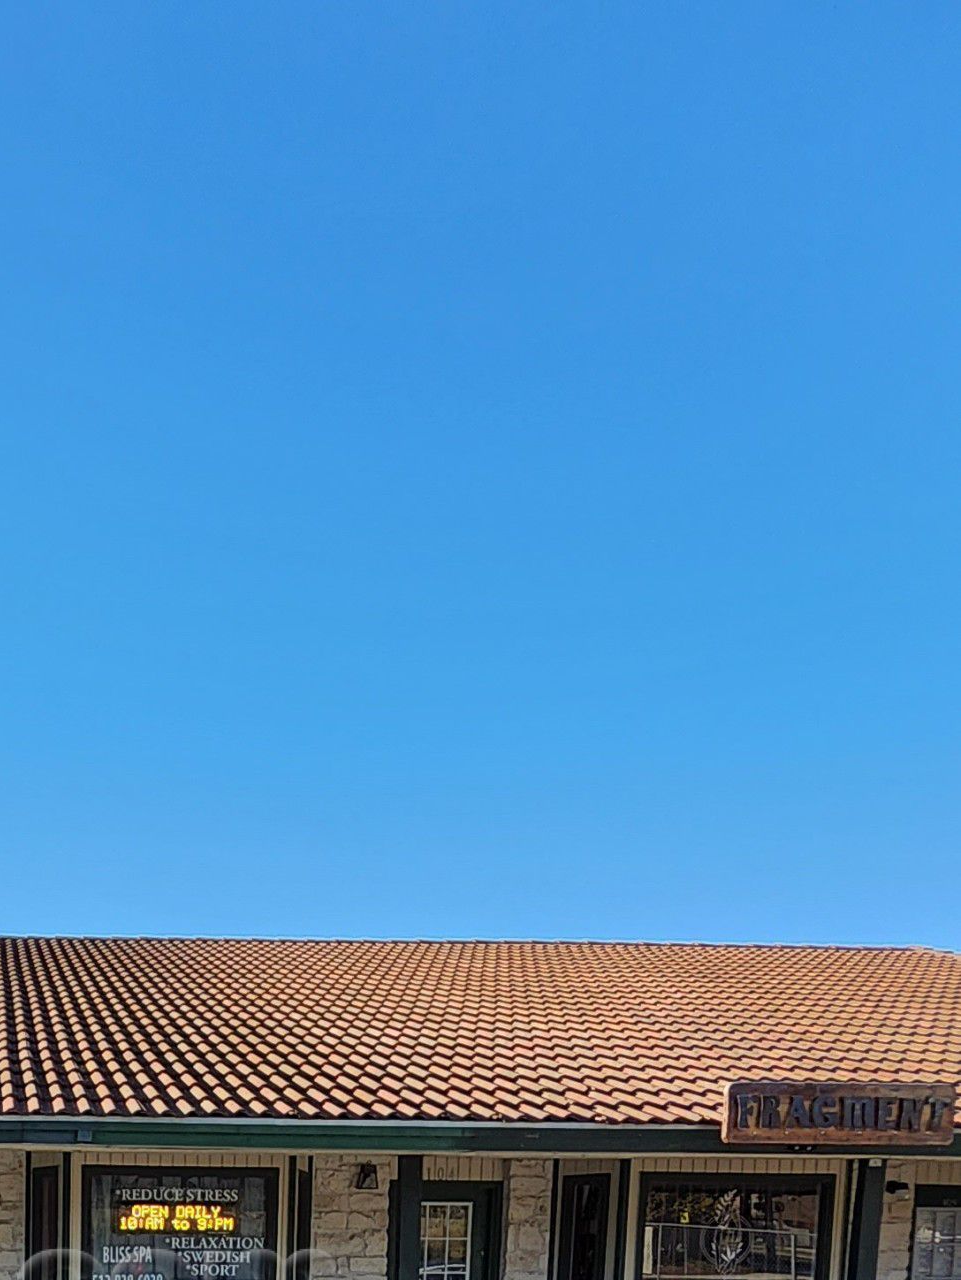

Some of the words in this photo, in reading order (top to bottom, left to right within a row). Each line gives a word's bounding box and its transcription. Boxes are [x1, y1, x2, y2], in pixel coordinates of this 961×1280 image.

[737, 1093, 952, 1131] FRAGMENT
[121, 1188, 184, 1201] REDUCE
[186, 1188, 239, 1202] STRESS
[131, 1204, 169, 1219] OPEN
[176, 1205, 221, 1220] DAILY
[171, 1218, 190, 1231] to
[170, 1236, 265, 1249] RELAXATION
[102, 1246, 131, 1263] BLISS
[133, 1246, 153, 1264] SPA
[182, 1251, 251, 1264] SWEDISH
[190, 1264, 239, 1277] SPORT
